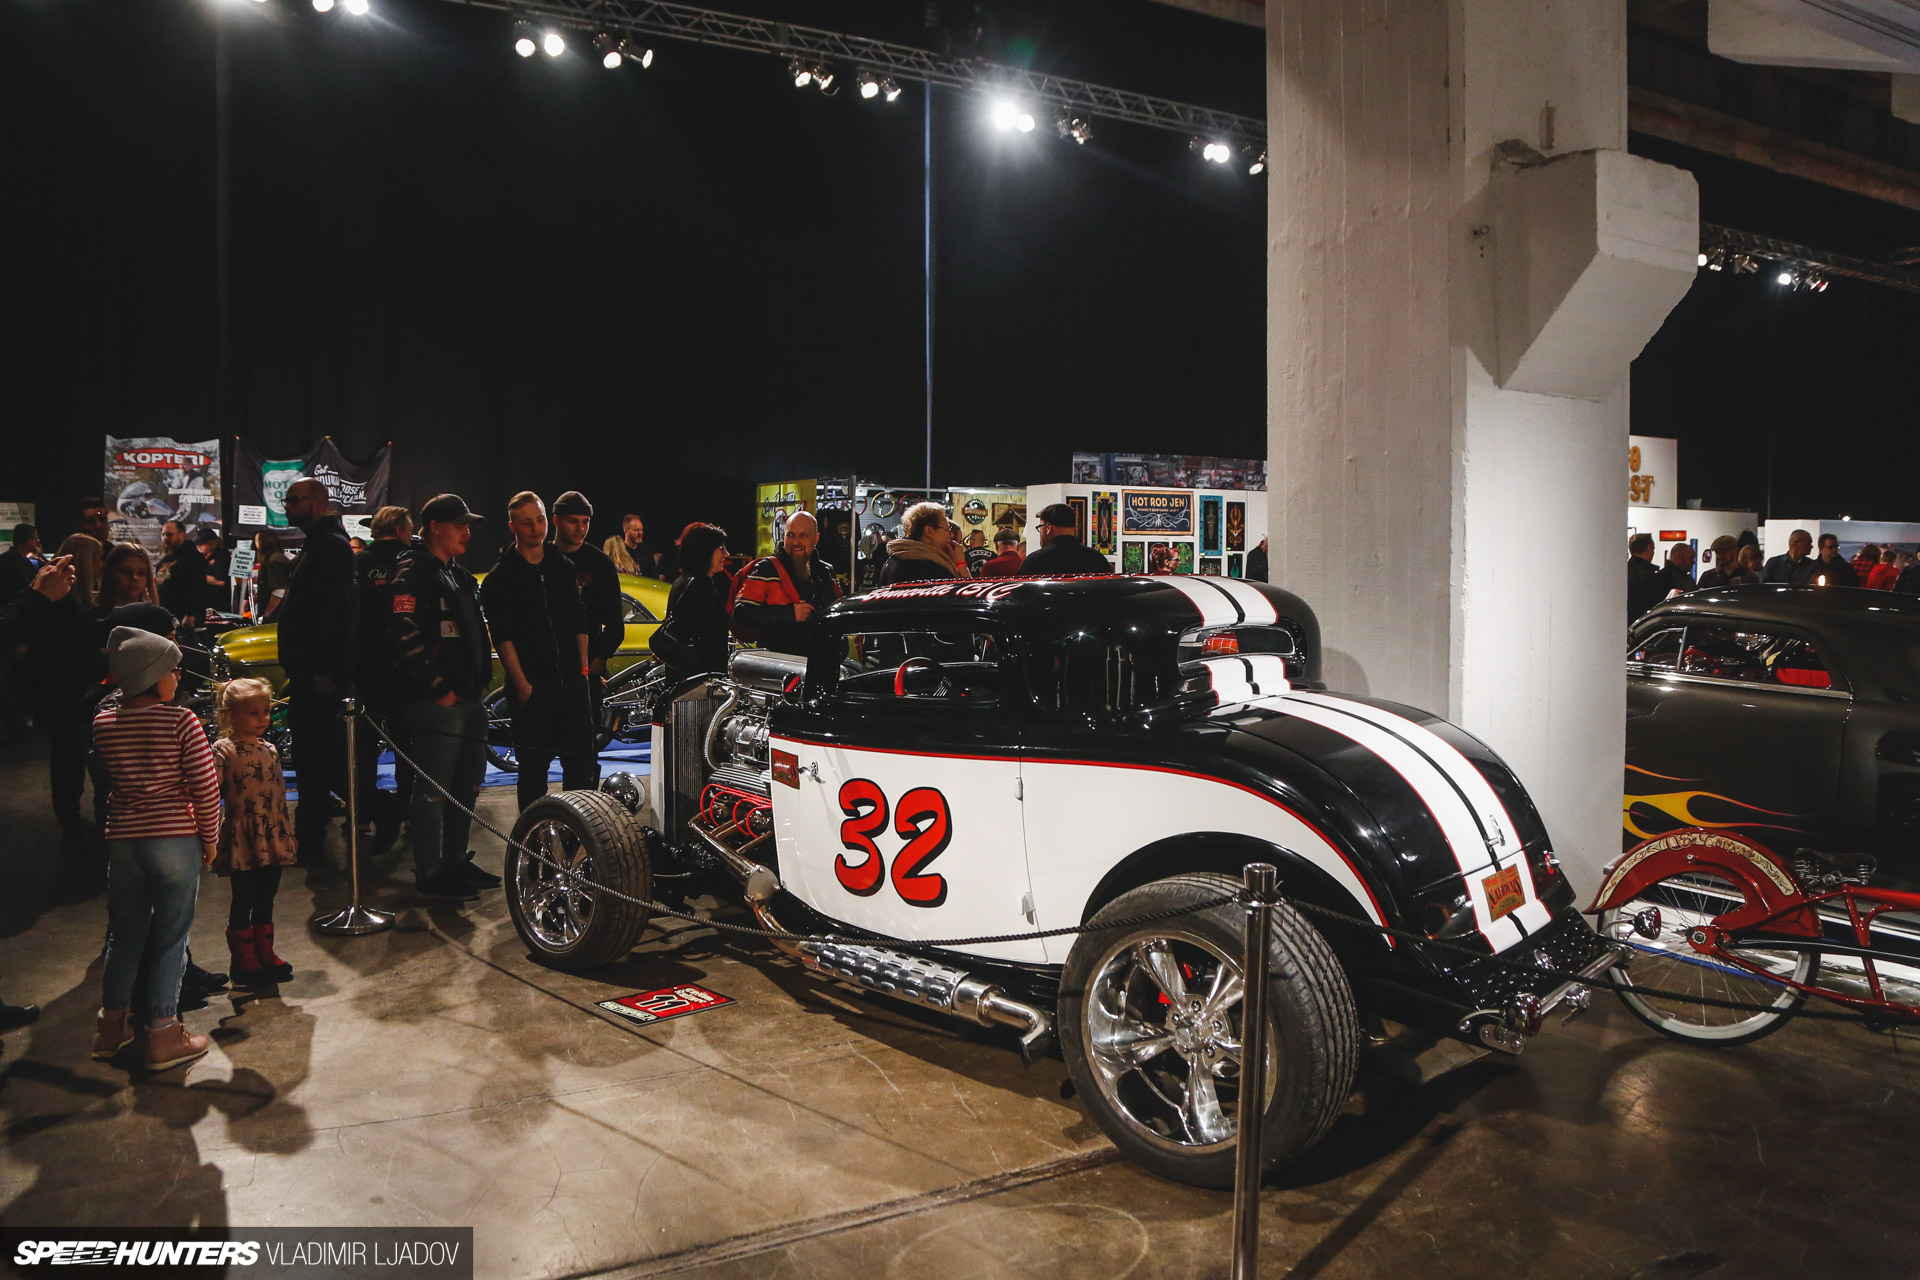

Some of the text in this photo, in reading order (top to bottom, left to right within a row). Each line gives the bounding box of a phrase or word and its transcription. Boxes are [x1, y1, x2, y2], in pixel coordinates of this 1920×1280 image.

[123, 452, 204, 465] KOPTERI
[313, 464, 329, 475] Get
[264, 480, 290, 489] MOT
[1131, 496, 1185, 507] HOT ROD JEN
[834, 777, 953, 909] 32
[635, 994, 690, 1013] 11
